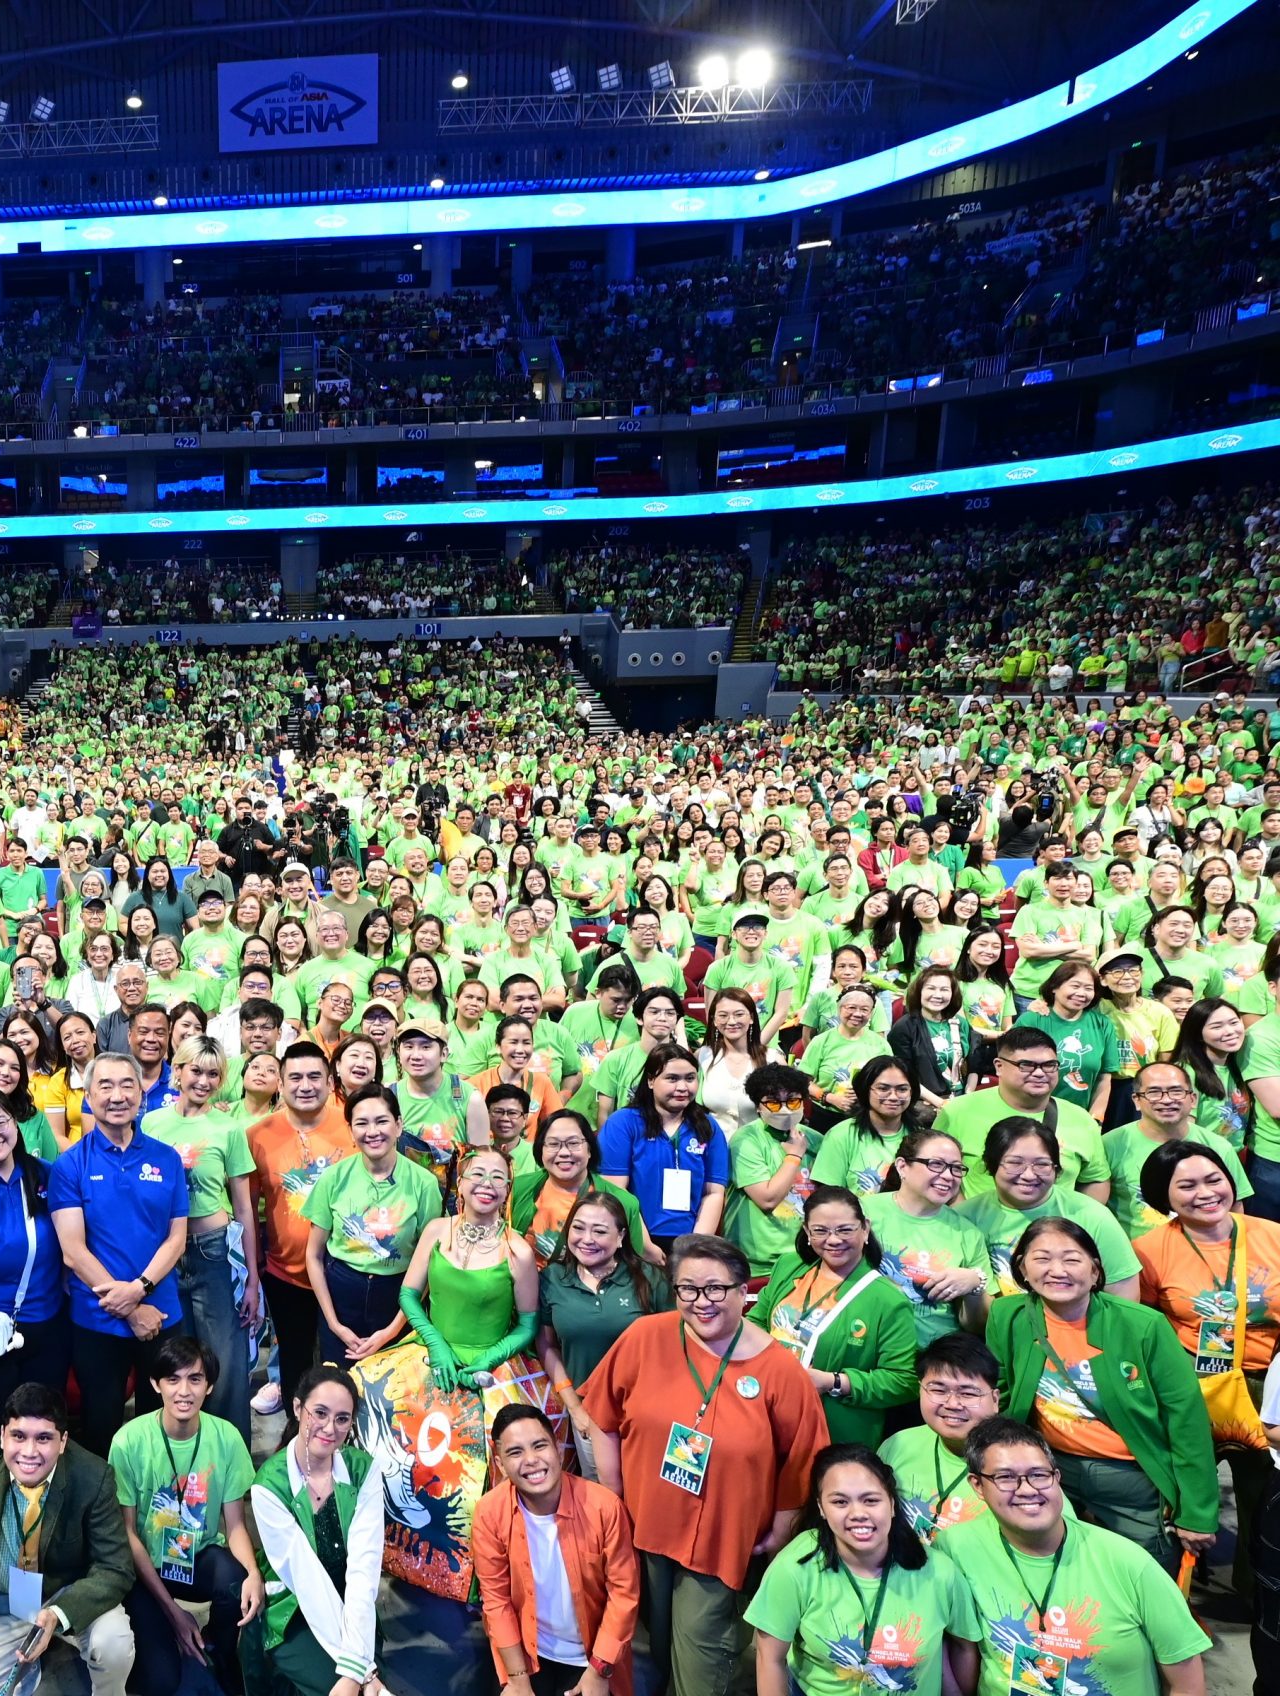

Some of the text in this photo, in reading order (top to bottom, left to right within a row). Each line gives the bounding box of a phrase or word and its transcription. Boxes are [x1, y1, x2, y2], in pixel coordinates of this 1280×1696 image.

[301, 92, 329, 102] ASIA
[248, 104, 344, 137] ARENA
[958, 202, 982, 215] 503A
[396, 273, 414, 284] 501
[810, 403, 837, 416] 403A
[618, 421, 641, 432] 402
[407, 429, 428, 440] 401
[175, 437, 197, 448] 422
[966, 498, 990, 511] 203
[608, 525, 629, 536] 202
[407, 531, 423, 542] 01
[183, 540, 201, 550] 222
[418, 623, 438, 636] 101
[159, 630, 179, 642] 122
[138, 1173, 163, 1183] CARES
[1209, 1358, 1225, 1367] ALL
[674, 1466, 690, 1480] ALL
[664, 1470, 698, 1492] ACCESS
[171, 1564, 184, 1574] ALL
[163, 1571, 191, 1583] ACCESS
[1041, 1639, 1081, 1650] FOR AUTISM
